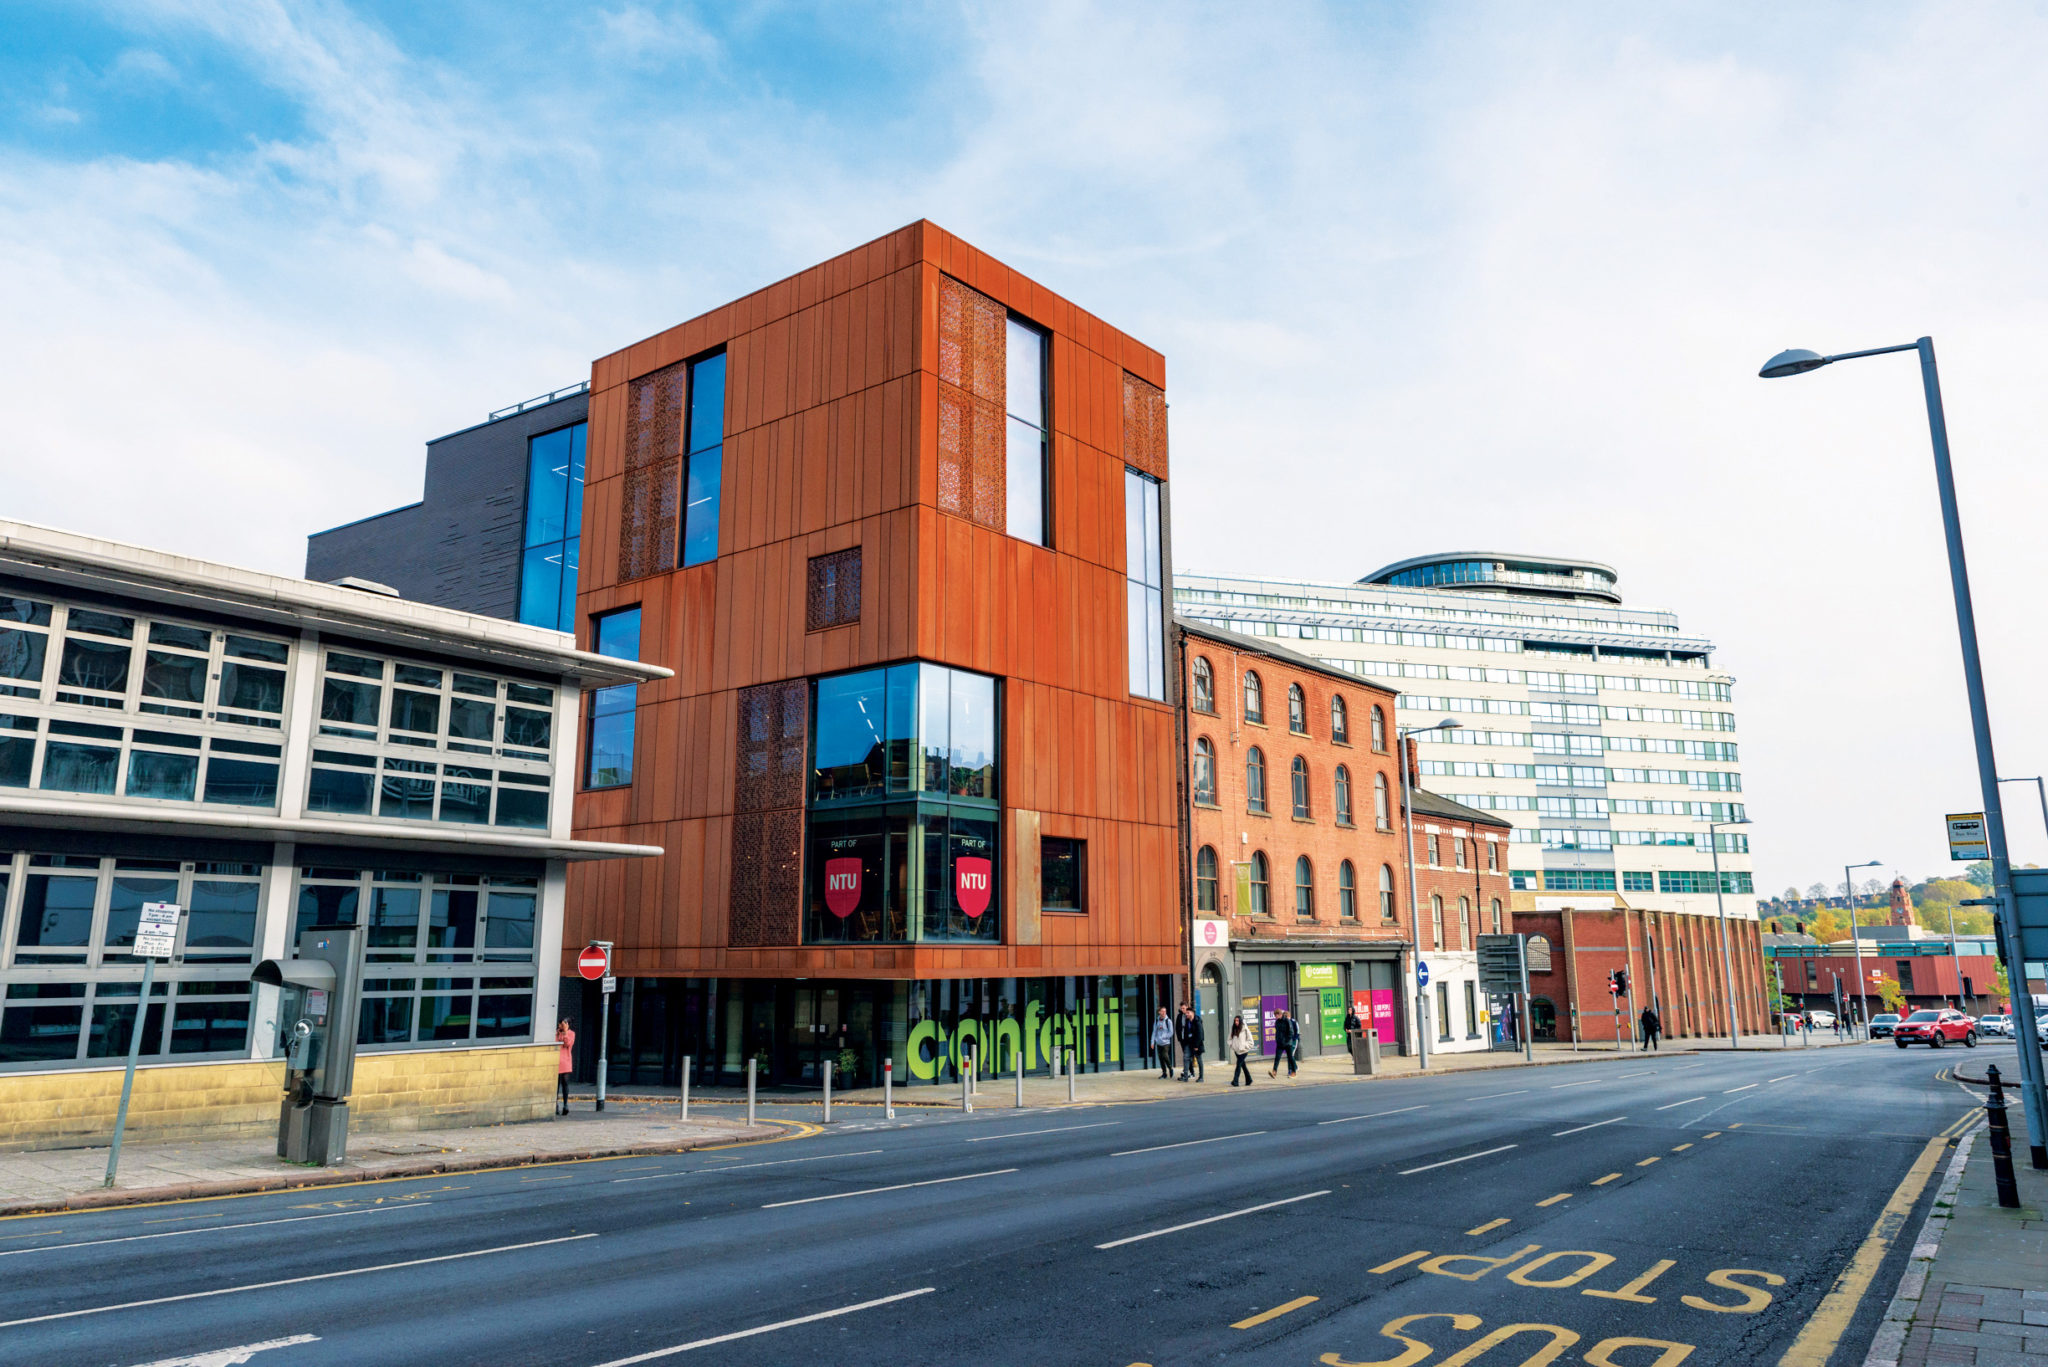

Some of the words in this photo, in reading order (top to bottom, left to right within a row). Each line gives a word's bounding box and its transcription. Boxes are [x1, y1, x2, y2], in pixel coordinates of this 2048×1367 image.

[831, 840, 847, 848] PART
[848, 839, 857, 847] OF
[961, 838, 976, 847] PART
[977, 840, 986, 848] OF
[829, 872, 857, 890] NTU
[961, 872, 986, 890] NTU
[1323, 992, 1342, 1009] HELLO
[906, 997, 1120, 1080] confetti
[1418, 1244, 1786, 1314] STOP
